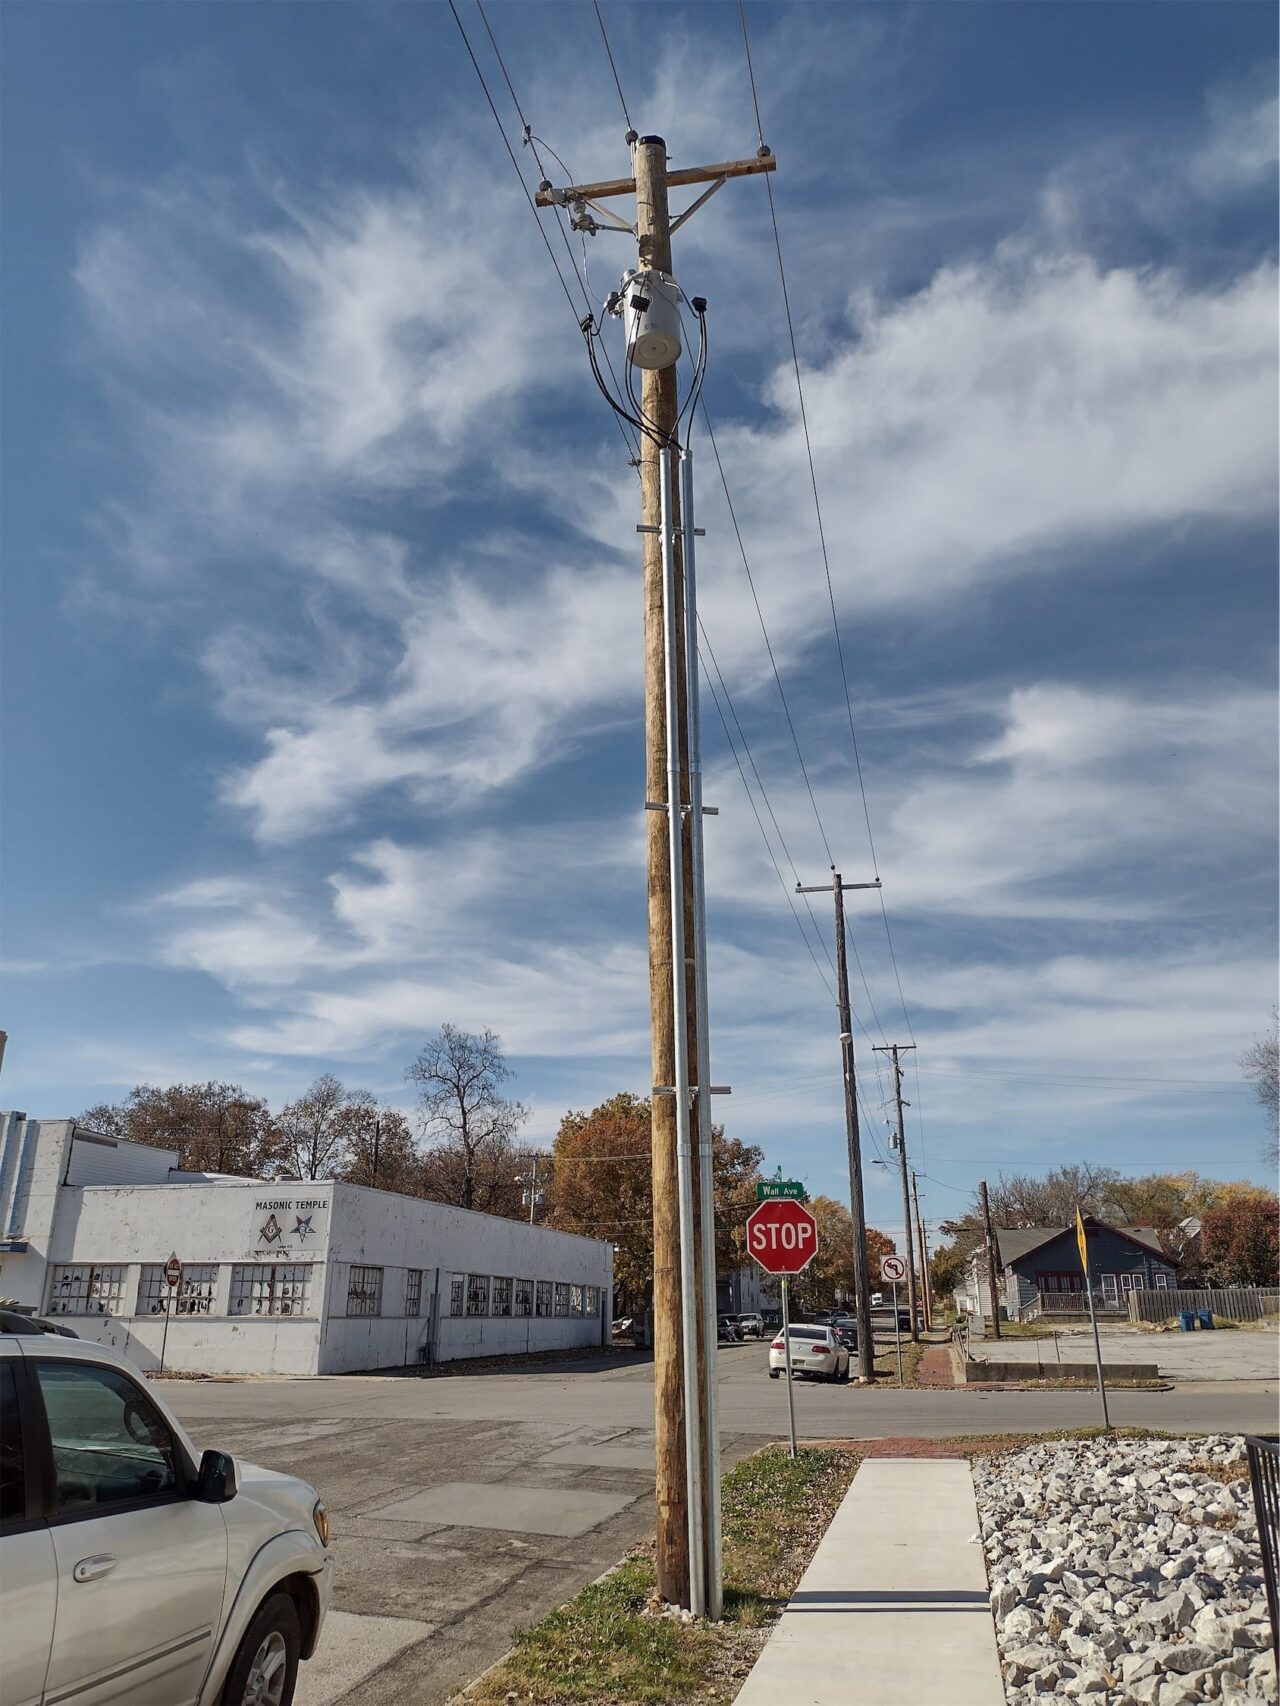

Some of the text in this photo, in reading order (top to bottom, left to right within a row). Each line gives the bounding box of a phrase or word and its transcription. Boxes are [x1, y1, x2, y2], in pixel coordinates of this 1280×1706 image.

[762, 1185, 798, 1196] Wall Ave
[255, 1200, 328, 1210] MASONIC TEMPLE
[267, 1225, 274, 1233] G
[752, 1222, 812, 1250] STOP
